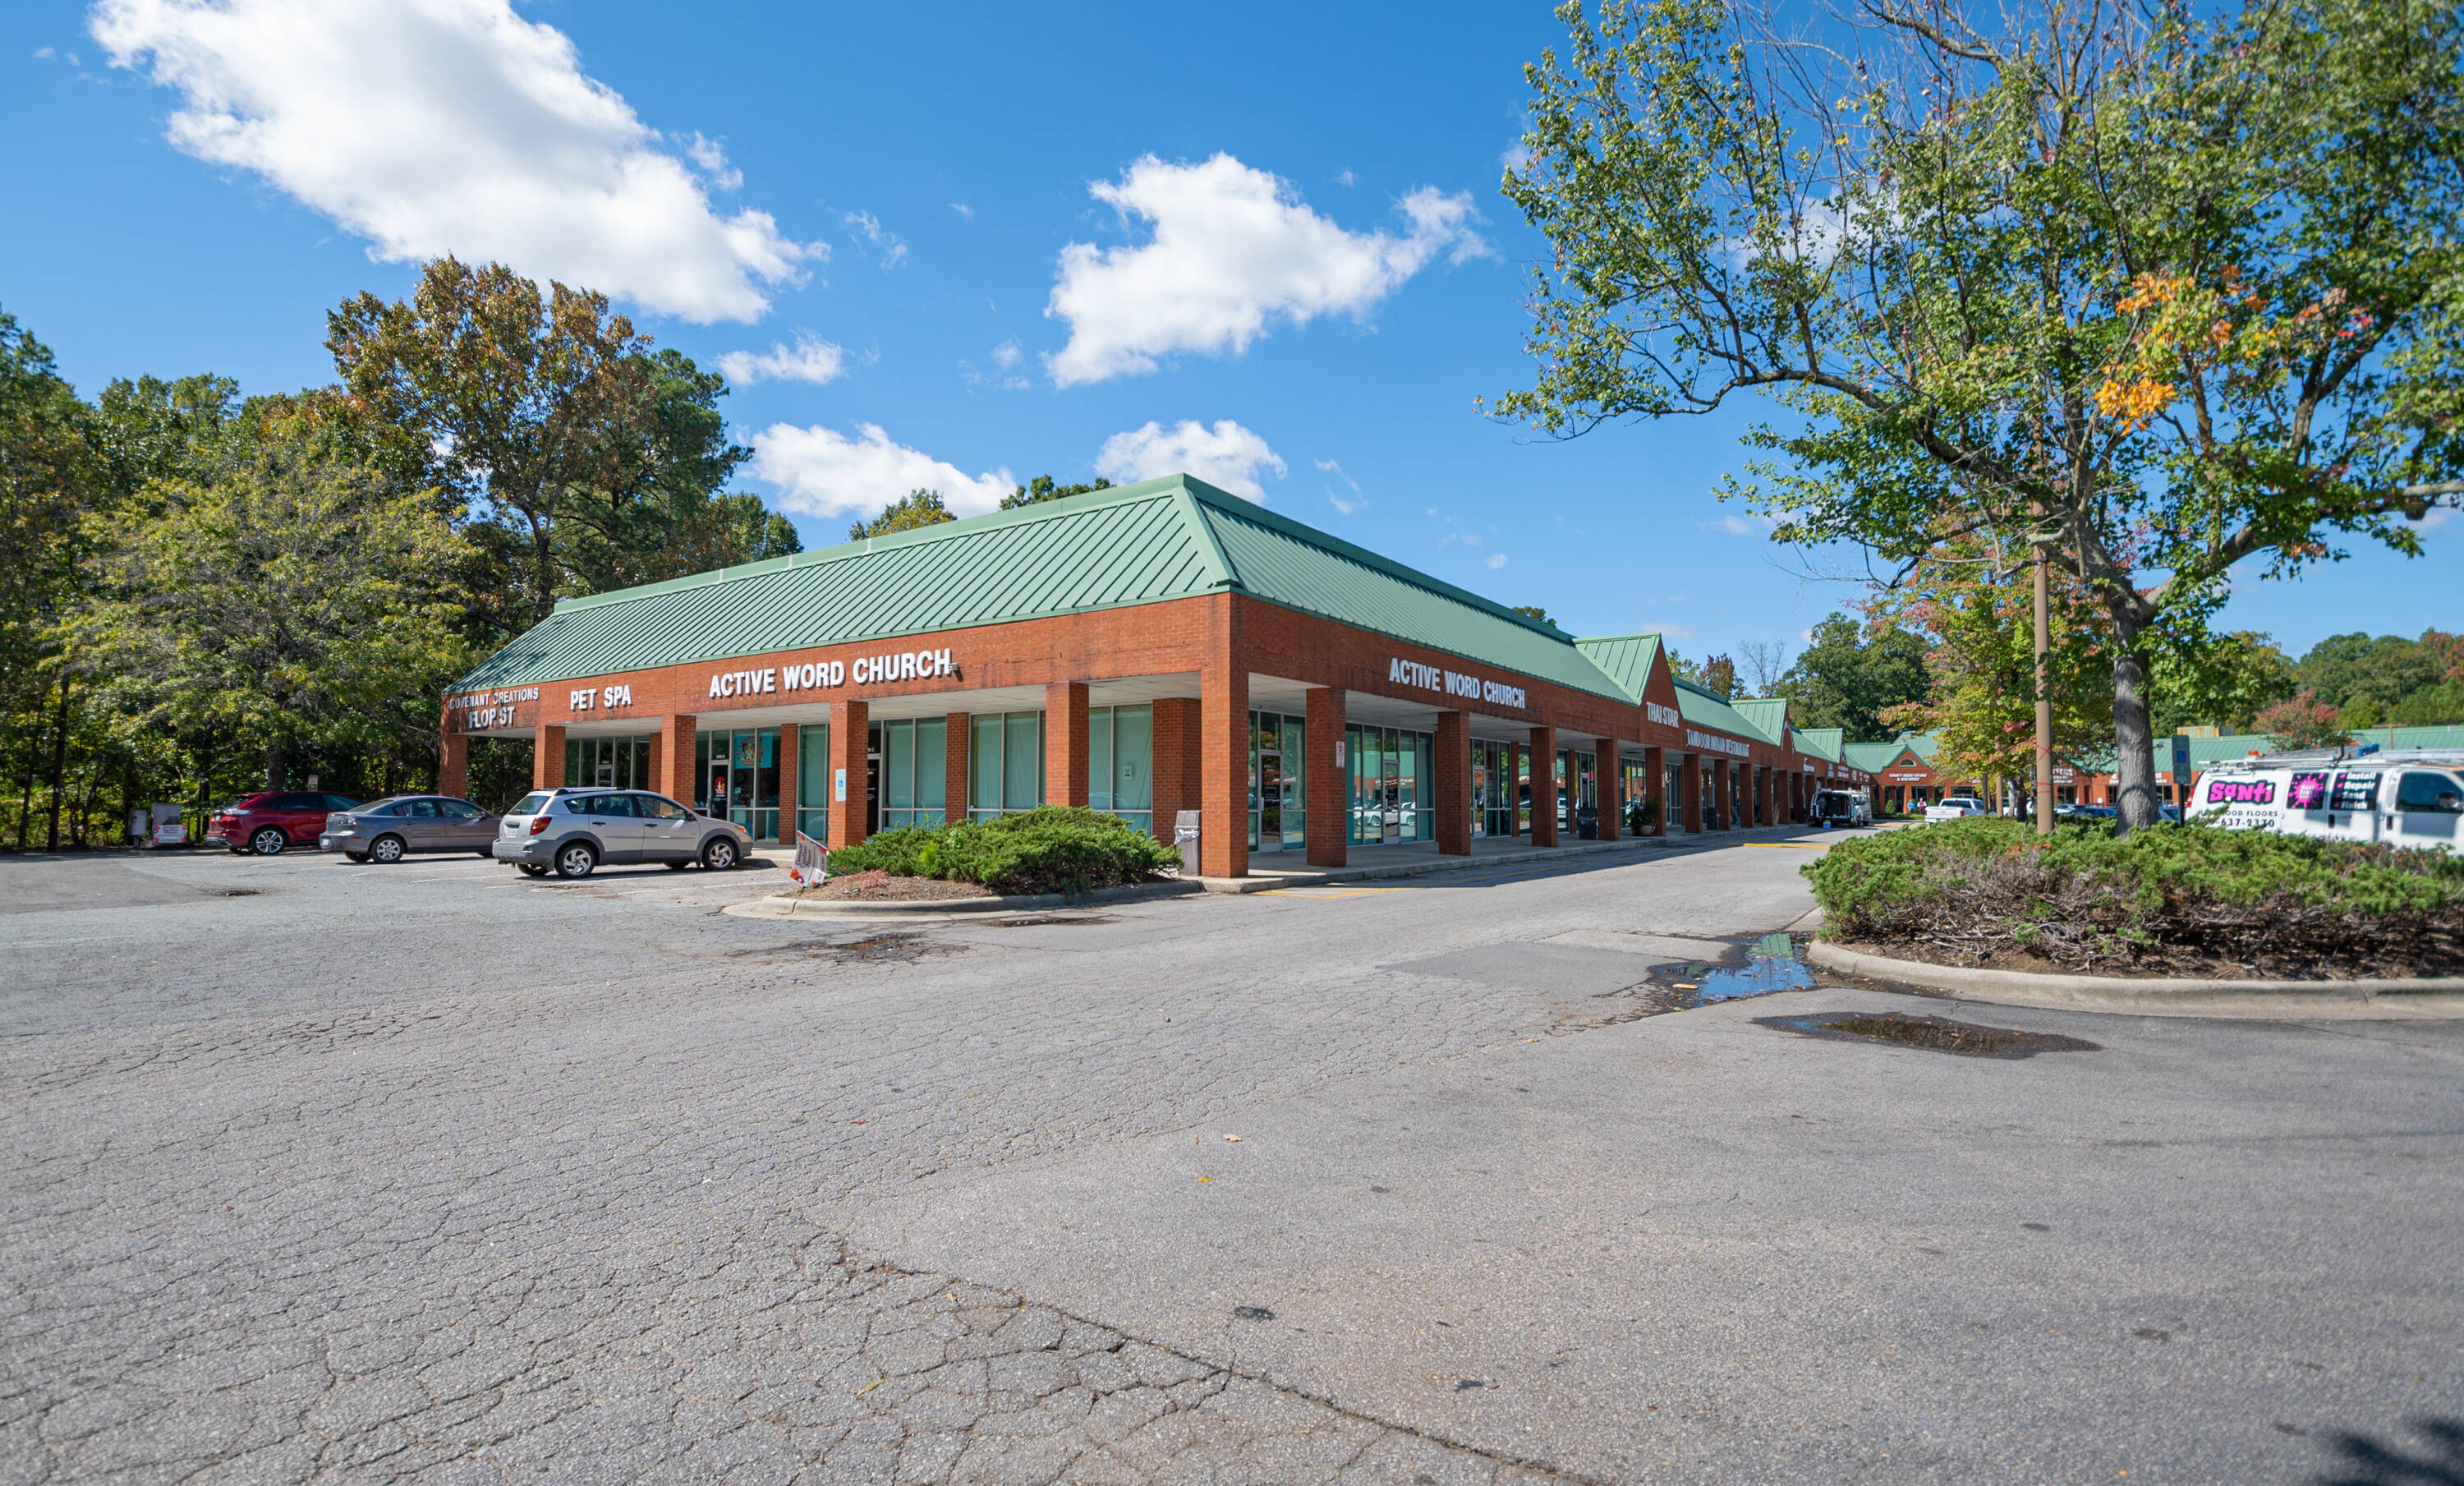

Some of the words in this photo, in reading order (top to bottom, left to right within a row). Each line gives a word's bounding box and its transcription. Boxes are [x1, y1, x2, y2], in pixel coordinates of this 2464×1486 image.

[709, 668, 777, 698] ACTIVE
[783, 660, 846, 691] WORD
[853, 648, 952, 685] CHURCH
[1388, 657, 1441, 692] ACTIVE
[1443, 670, 1481, 699] WORD
[1483, 680, 1526, 709] CHURCH
[448, 693, 491, 711] COVENANT
[493, 687, 540, 706] CREATIONS
[570, 688, 597, 711] PET
[604, 684, 632, 708] SPA
[1646, 701, 1662, 725] THAI
[1662, 706, 1680, 729] STAR
[2342, 791, 2366, 799] Sand
[2343, 781, 2376, 790] Repair
[2341, 801, 2368, 809] Finish
